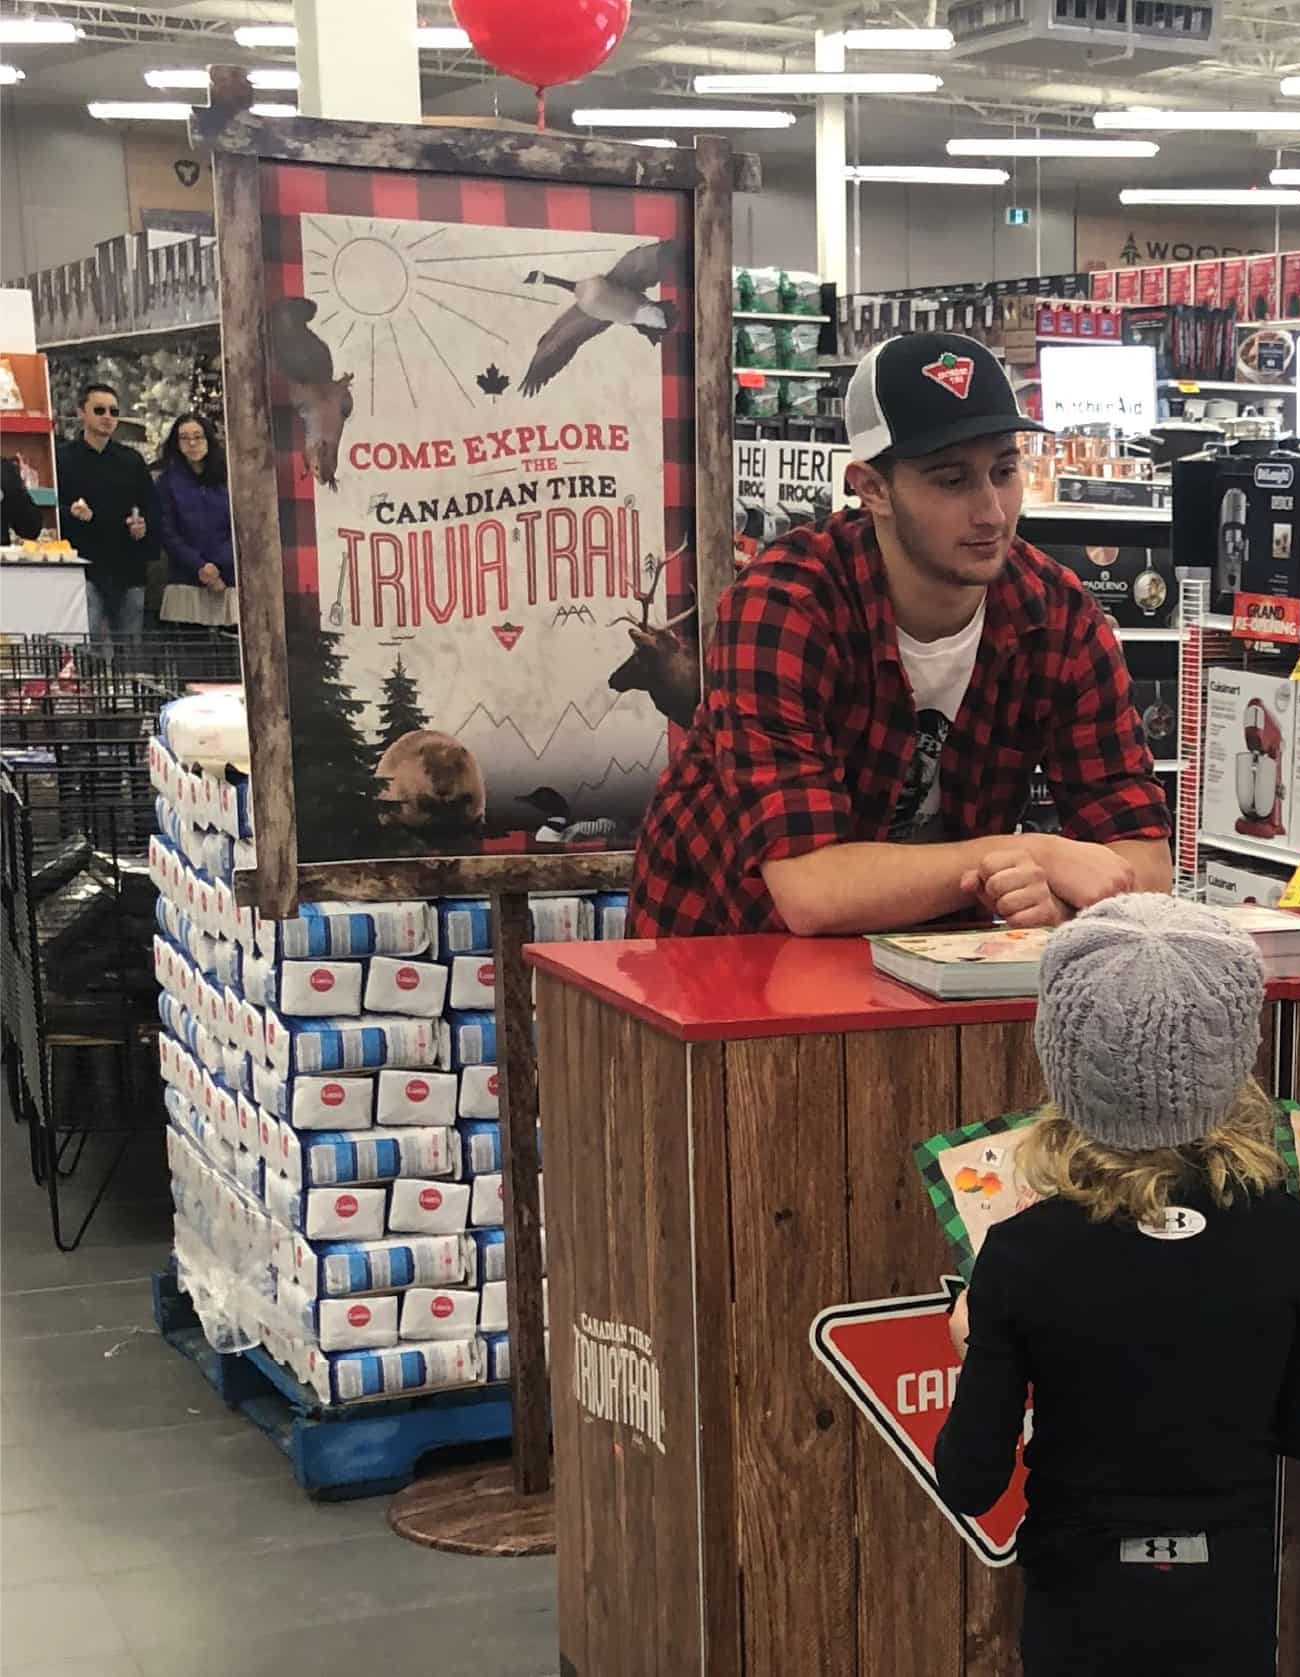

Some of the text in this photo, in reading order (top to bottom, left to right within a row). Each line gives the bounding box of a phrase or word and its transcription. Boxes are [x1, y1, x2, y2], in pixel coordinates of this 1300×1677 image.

[349, 423, 630, 470] COME EXPLORE
[521, 457, 559, 473] THE
[375, 475, 617, 525] CANADIAN TIRE
[337, 505, 654, 628] TRIVIA TRAIL
[1247, 603, 1285, 618] GRAND
[580, 1312, 653, 1356] CANADIAN TIRE
[573, 1323, 666, 1455] TRIVIA TRAIL
